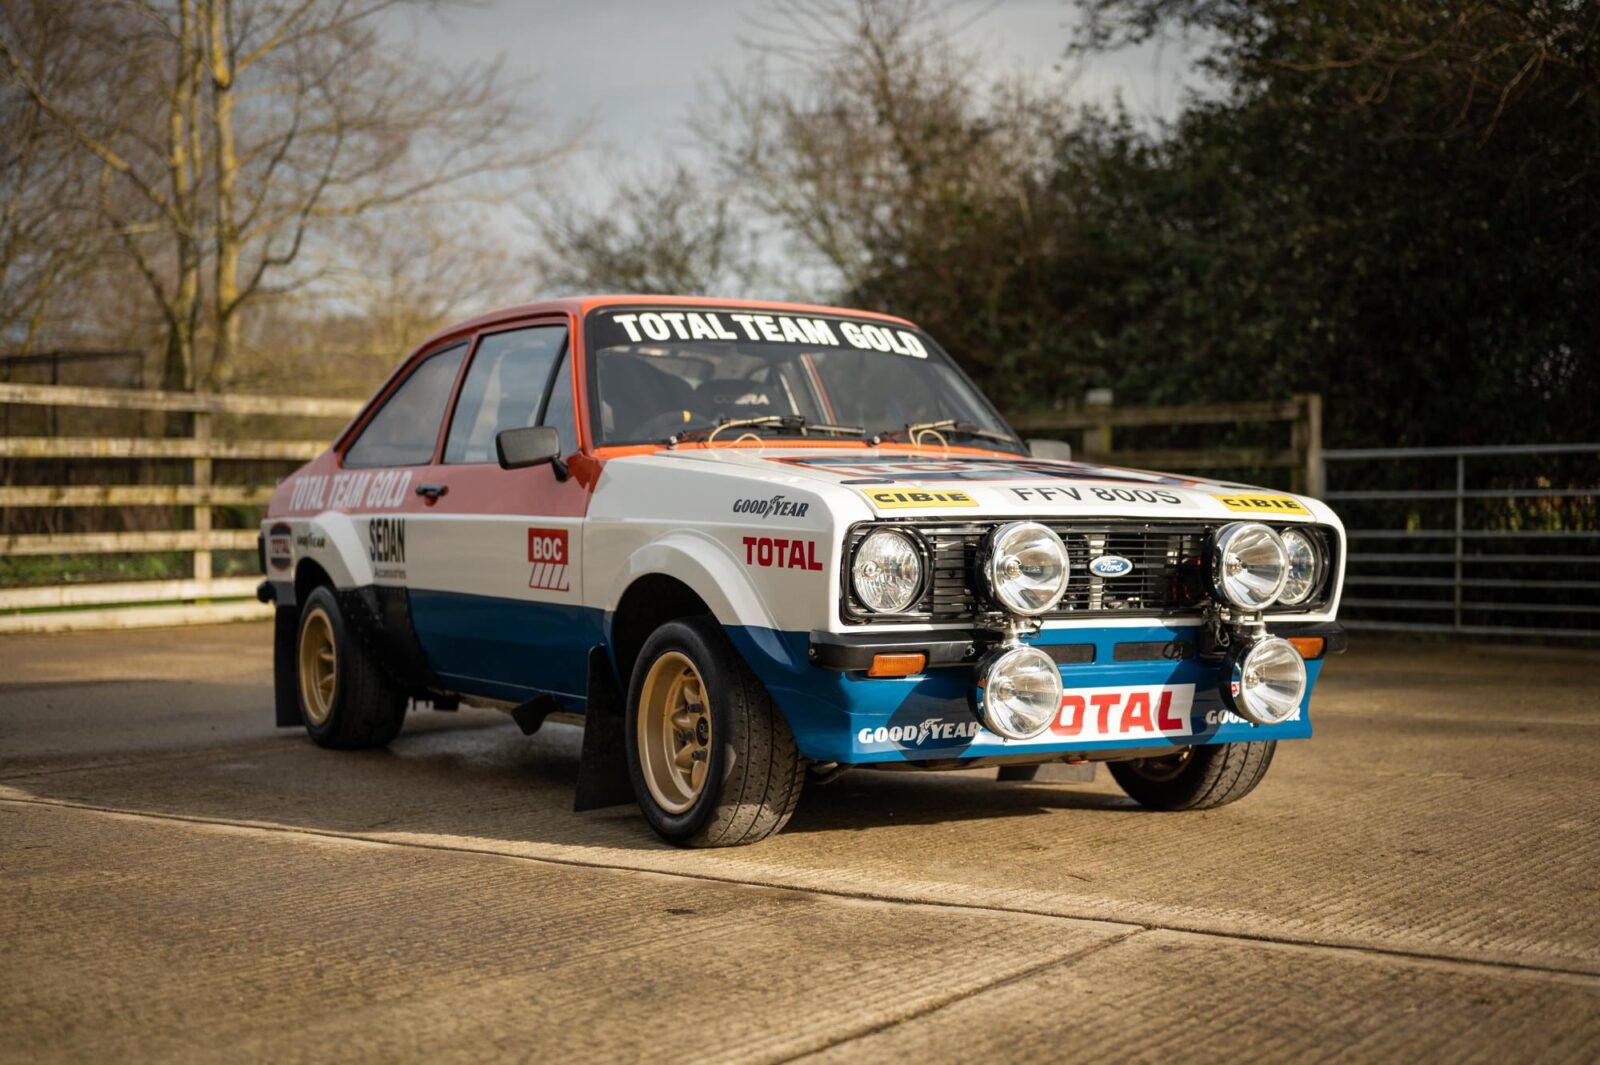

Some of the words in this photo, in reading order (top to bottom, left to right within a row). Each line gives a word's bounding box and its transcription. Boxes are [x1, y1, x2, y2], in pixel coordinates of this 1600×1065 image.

[613, 312, 738, 342] TOTAL
[731, 314, 840, 347] TEAM
[839, 321, 929, 359] GOLD
[289, 474, 328, 511] TOTAL
[327, 471, 373, 509] TEAM
[366, 470, 413, 508] GOLD
[874, 493, 971, 503] CIBIE
[1009, 487, 1083, 502] FFV
[1094, 487, 1183, 505] 800S
[733, 495, 809, 519] GOODYEAR
[369, 517, 406, 564] SEDAN
[533, 536, 563, 561] BOC
[743, 536, 823, 571] TOTAL
[1050, 691, 1183, 736] OTAL
[858, 718, 981, 746] GOODYEAR
